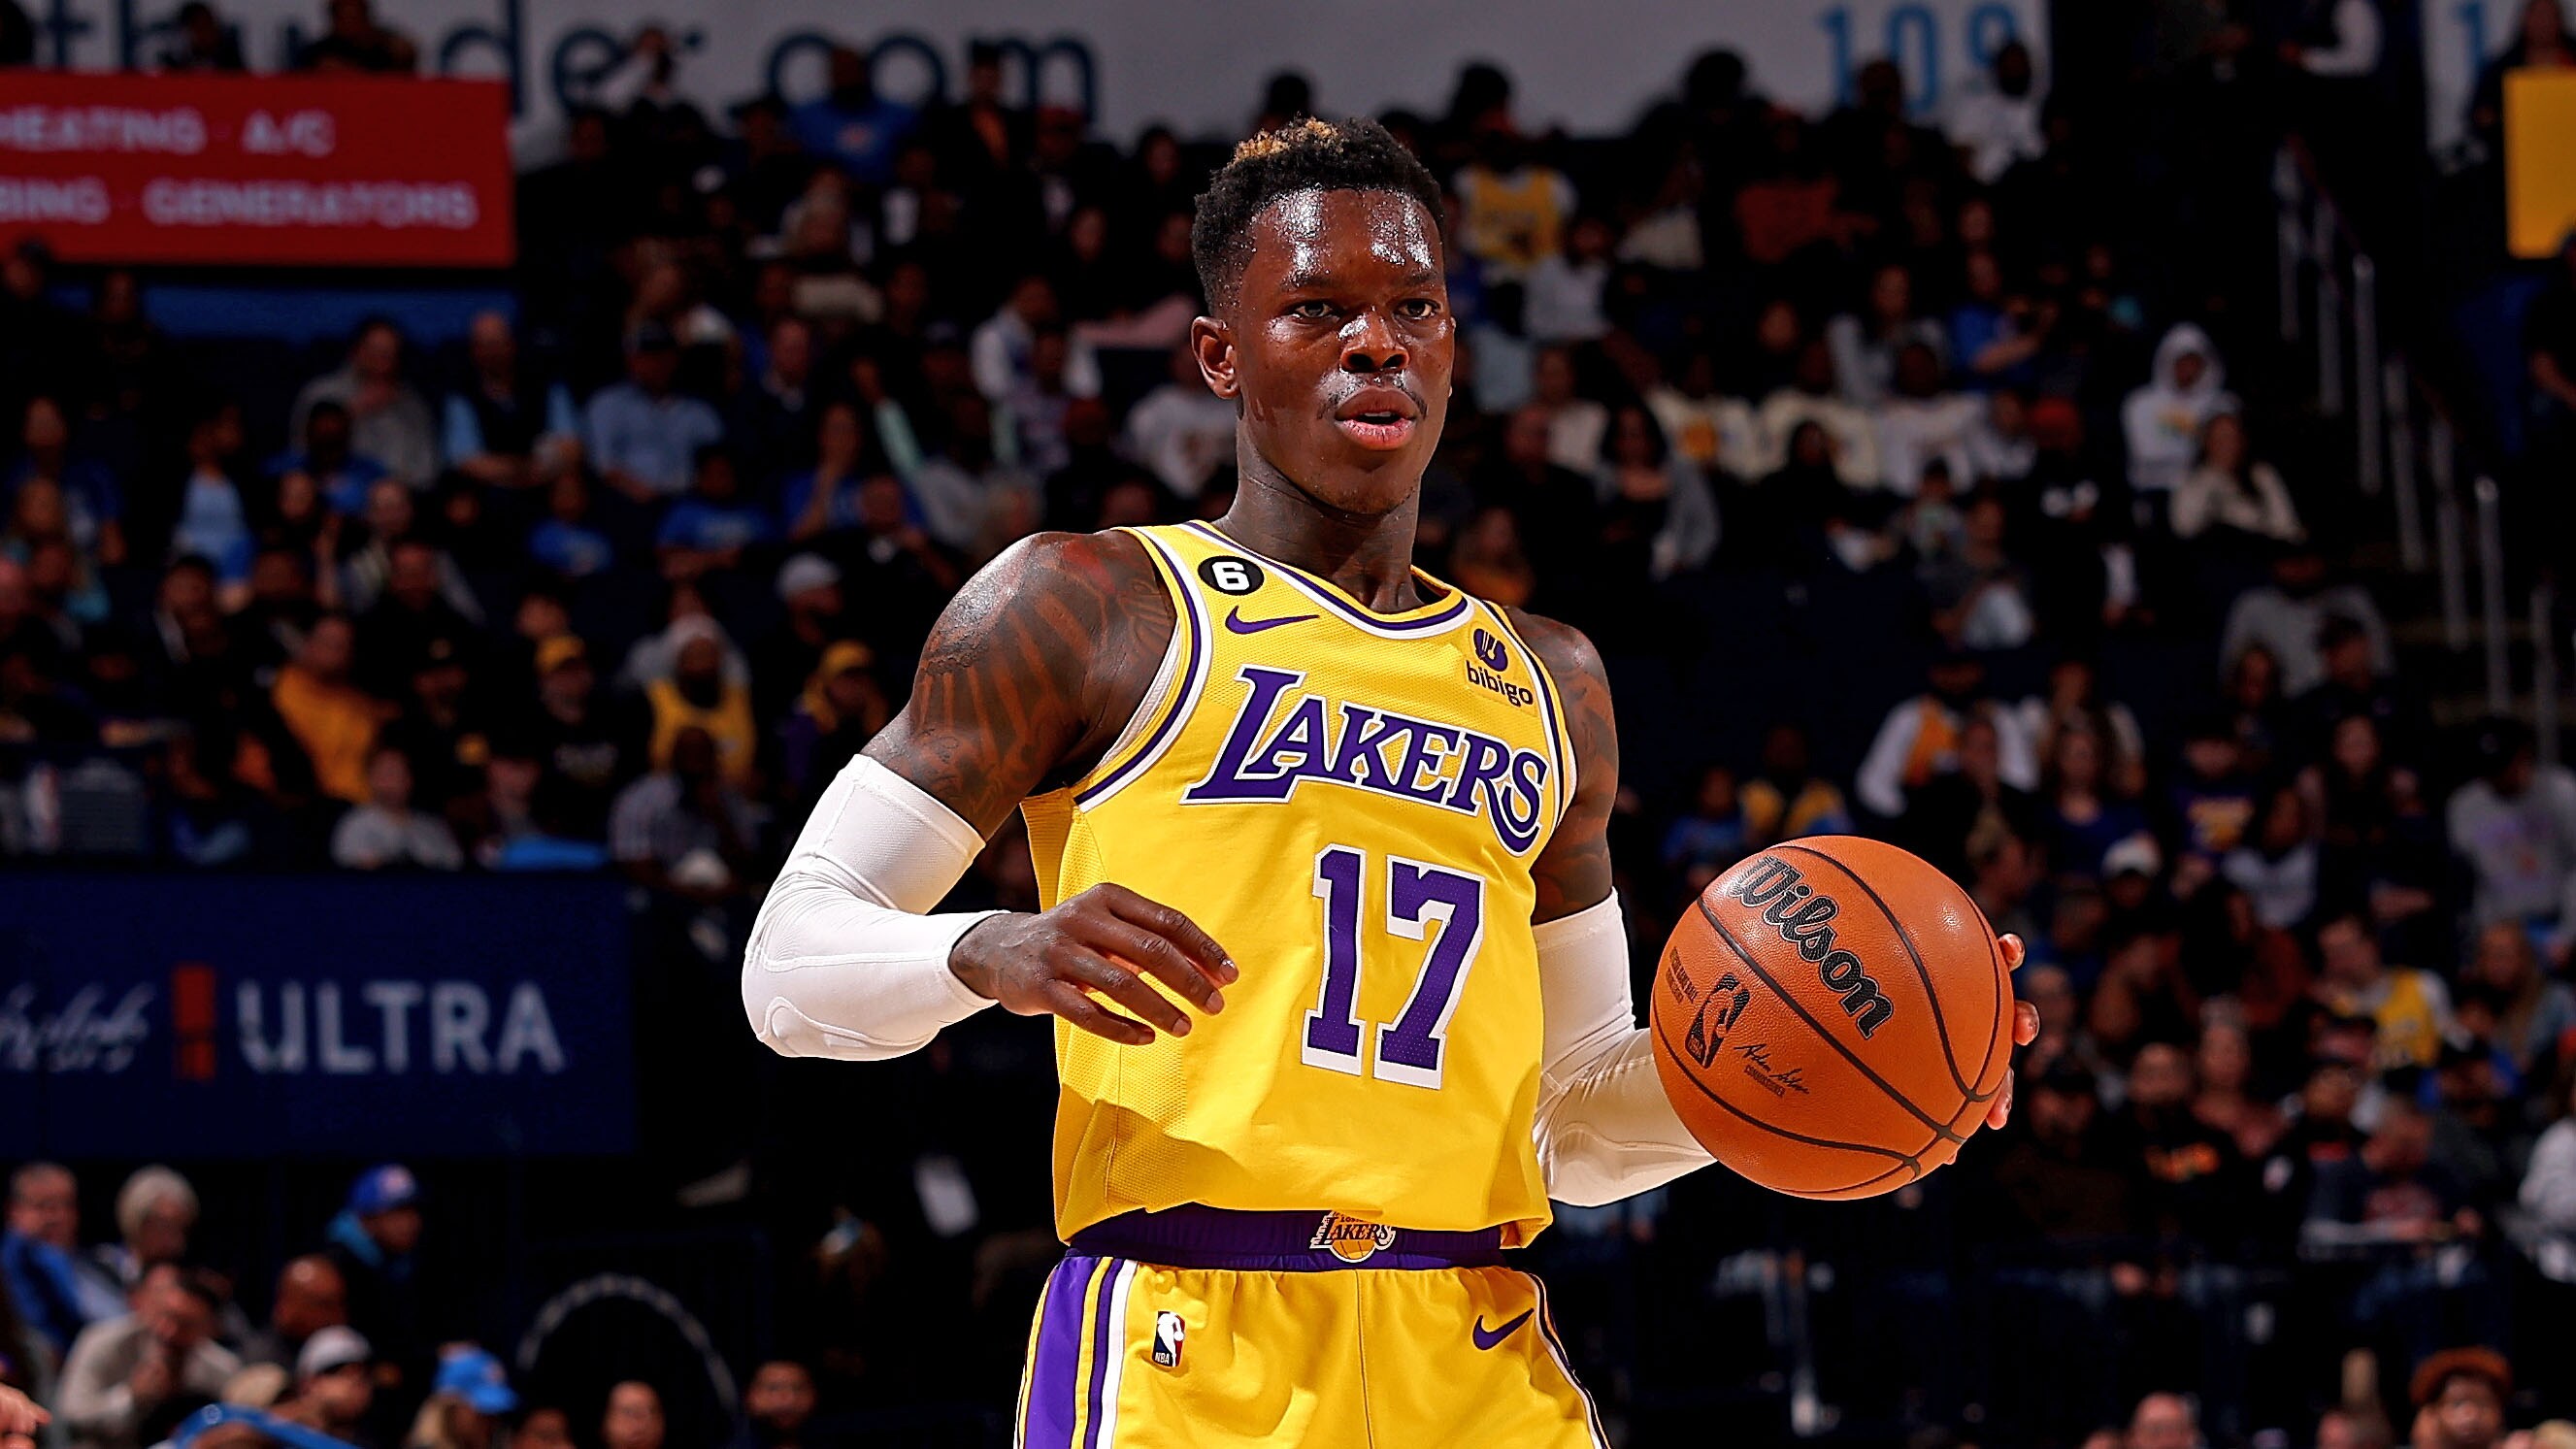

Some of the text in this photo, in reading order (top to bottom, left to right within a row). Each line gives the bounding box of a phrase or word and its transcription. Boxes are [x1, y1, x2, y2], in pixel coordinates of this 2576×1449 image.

[144, 178, 479, 227] GENERATORS
[1209, 560, 1250, 591] 6
[1466, 660, 1533, 708] bibigo
[1181, 664, 1550, 856] LAKERS
[1302, 842, 1487, 1091] 17
[1730, 855, 1894, 1039] Wilson
[236, 977, 566, 1074] ULTRA
[1312, 1216, 1395, 1249] LAKERS
[1155, 1352, 1170, 1365] NBA
